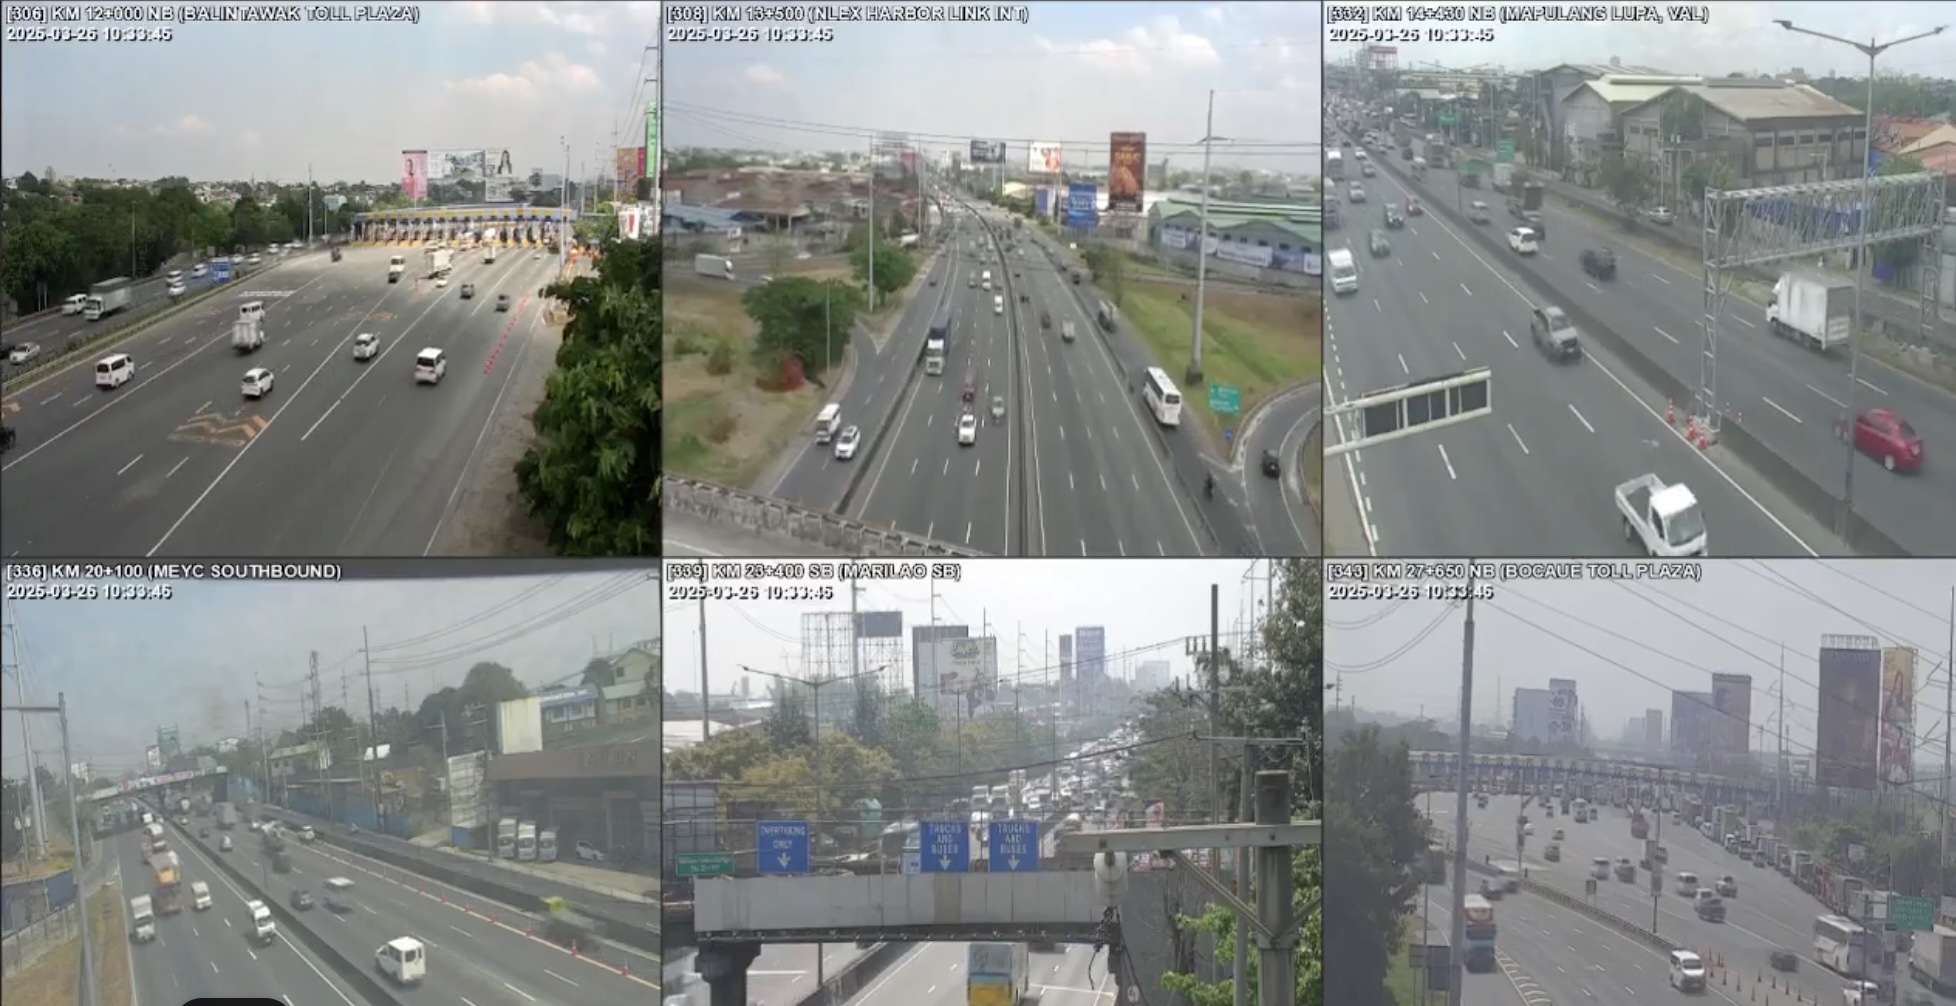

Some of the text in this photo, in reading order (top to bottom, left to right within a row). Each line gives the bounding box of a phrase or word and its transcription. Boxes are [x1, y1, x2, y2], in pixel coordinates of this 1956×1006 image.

[929, 823, 961, 833] TRUCKS
[998, 823, 1030, 833] TRUCKS
[937, 834, 953, 843] AND
[1005, 834, 1022, 843] AND
[773, 840, 793, 849] ONLY
[931, 845, 959, 854] BUSES
[1000, 845, 1027, 854] BUSES
